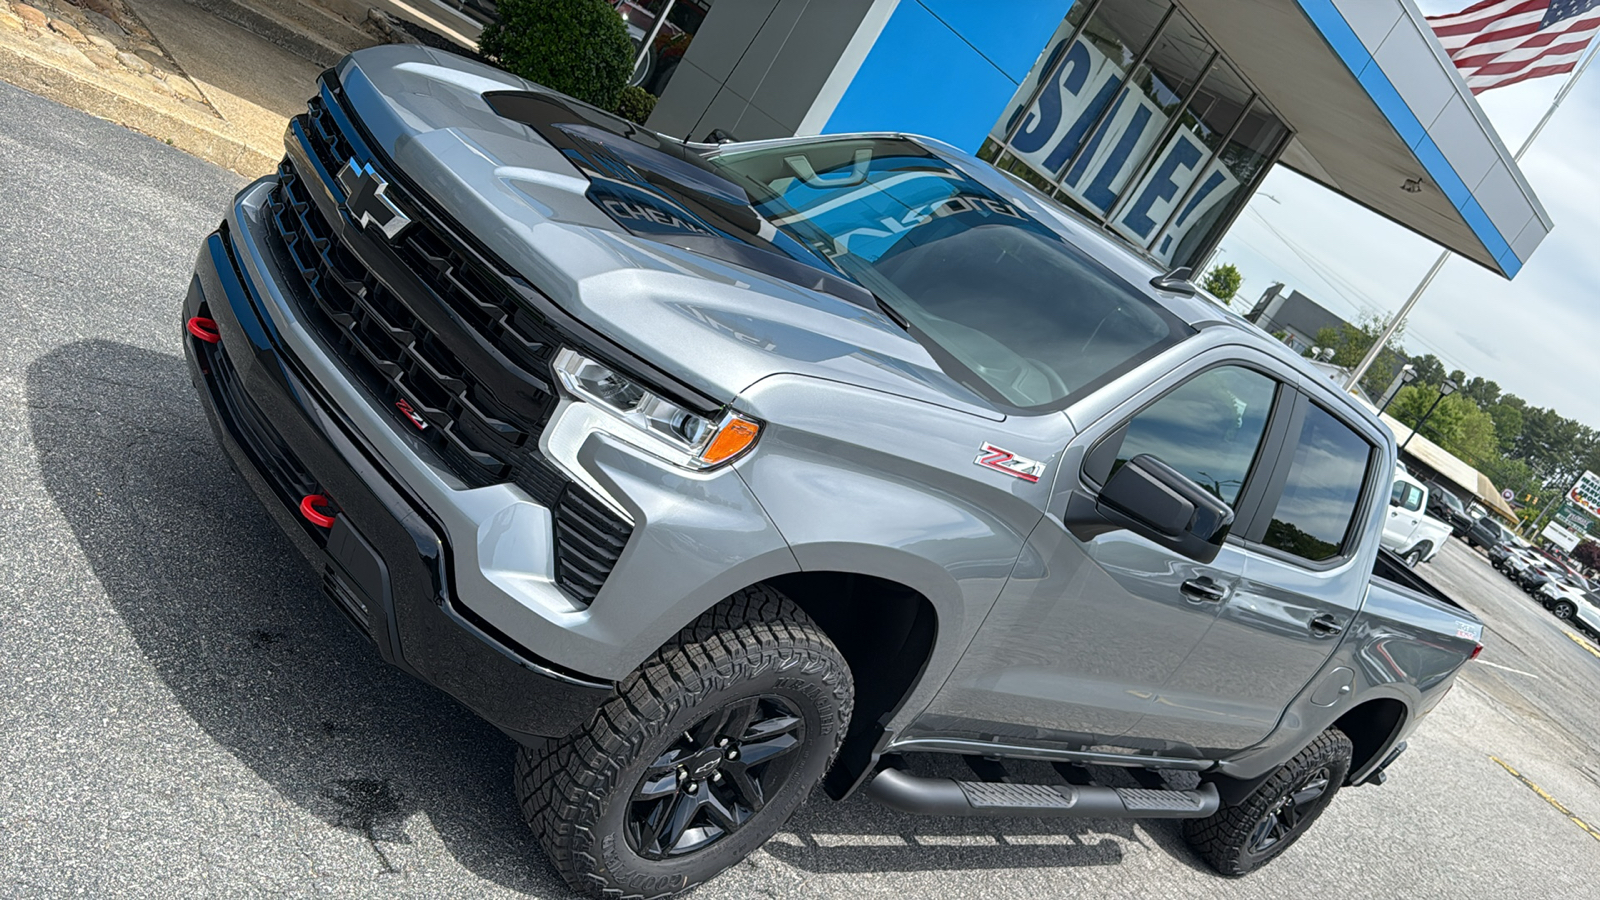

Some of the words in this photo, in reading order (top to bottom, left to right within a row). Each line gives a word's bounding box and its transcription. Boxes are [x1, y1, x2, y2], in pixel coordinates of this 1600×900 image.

[1006, 37, 1227, 256] SALE!
[396, 398, 428, 430] Z71
[973, 441, 1047, 483] Z71
